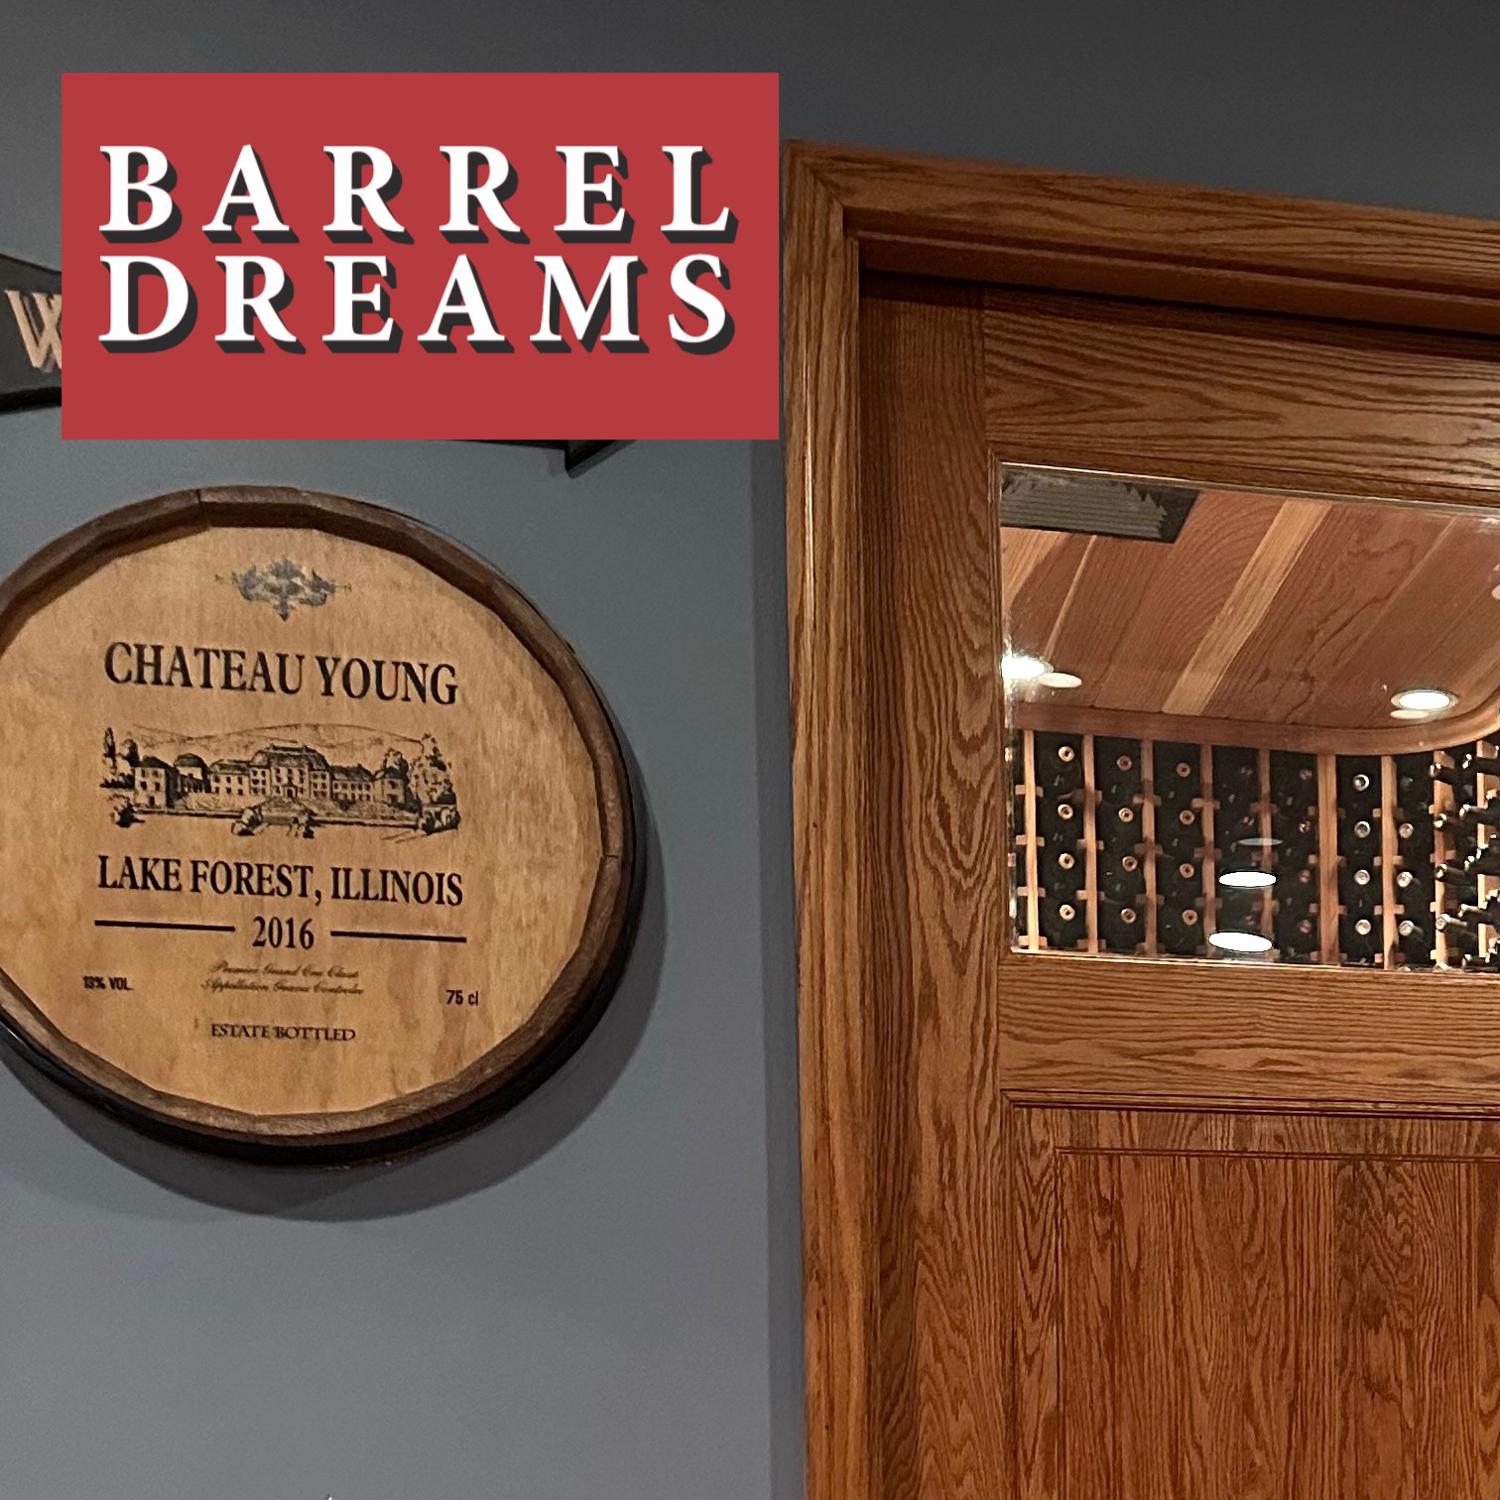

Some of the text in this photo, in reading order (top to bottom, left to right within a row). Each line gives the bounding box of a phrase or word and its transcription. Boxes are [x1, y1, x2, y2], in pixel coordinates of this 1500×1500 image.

[104, 641, 458, 705] CHATEAU YOUNG
[97, 855, 463, 906] LAKE FOREST, ILLINOIS
[252, 916, 315, 950] 2016
[446, 989, 479, 1007] 75 cl
[211, 1023, 357, 1042] ESTATE BOTTLED
